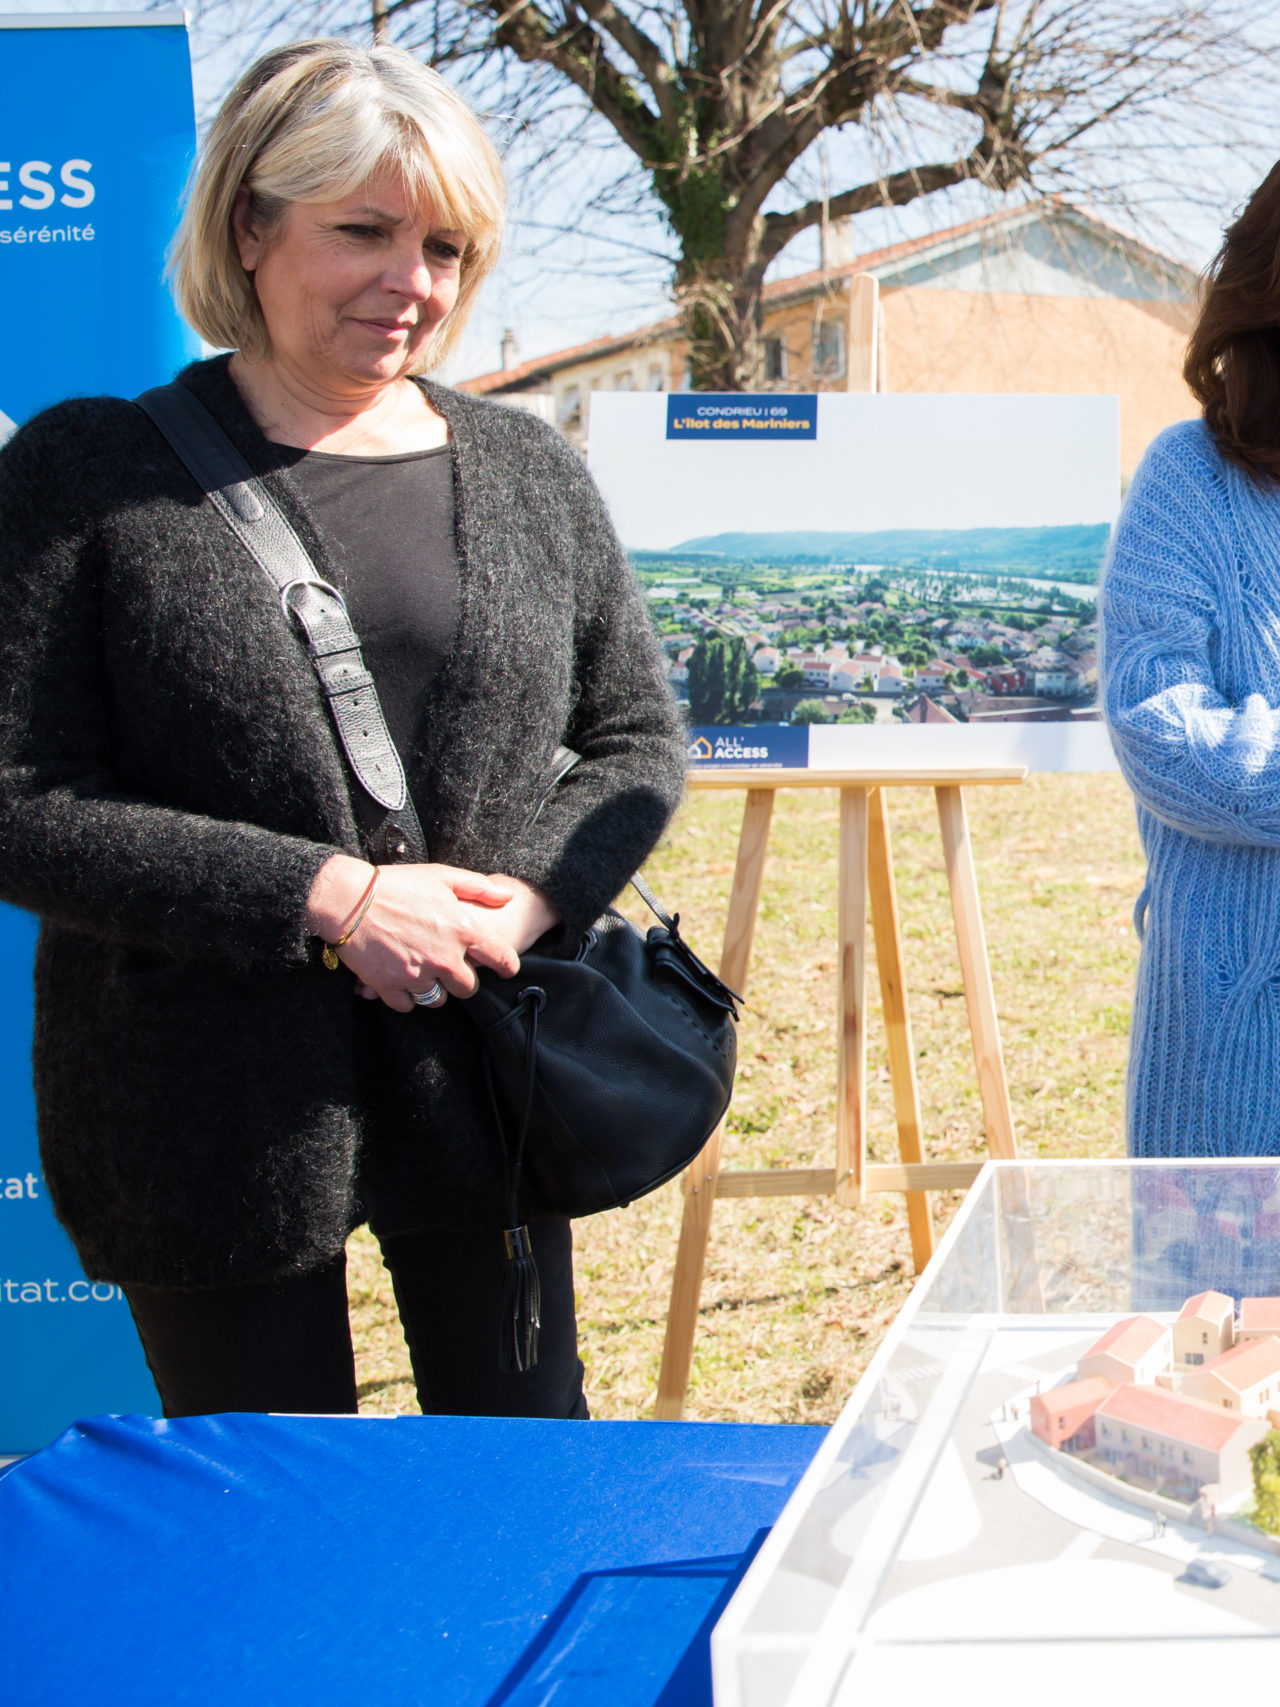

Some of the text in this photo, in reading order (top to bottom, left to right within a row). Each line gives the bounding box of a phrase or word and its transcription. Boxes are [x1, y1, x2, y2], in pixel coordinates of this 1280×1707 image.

[0, 223, 95, 243] sérénité
[697, 406, 762, 417] CONDRIEU
[770, 406, 788, 417] 69
[712, 418, 740, 430] des
[742, 418, 811, 430] Mariniers
[714, 747, 769, 759] ACCESS
[0, 1172, 38, 1199] at
[0, 1278, 122, 1303] tat.co
